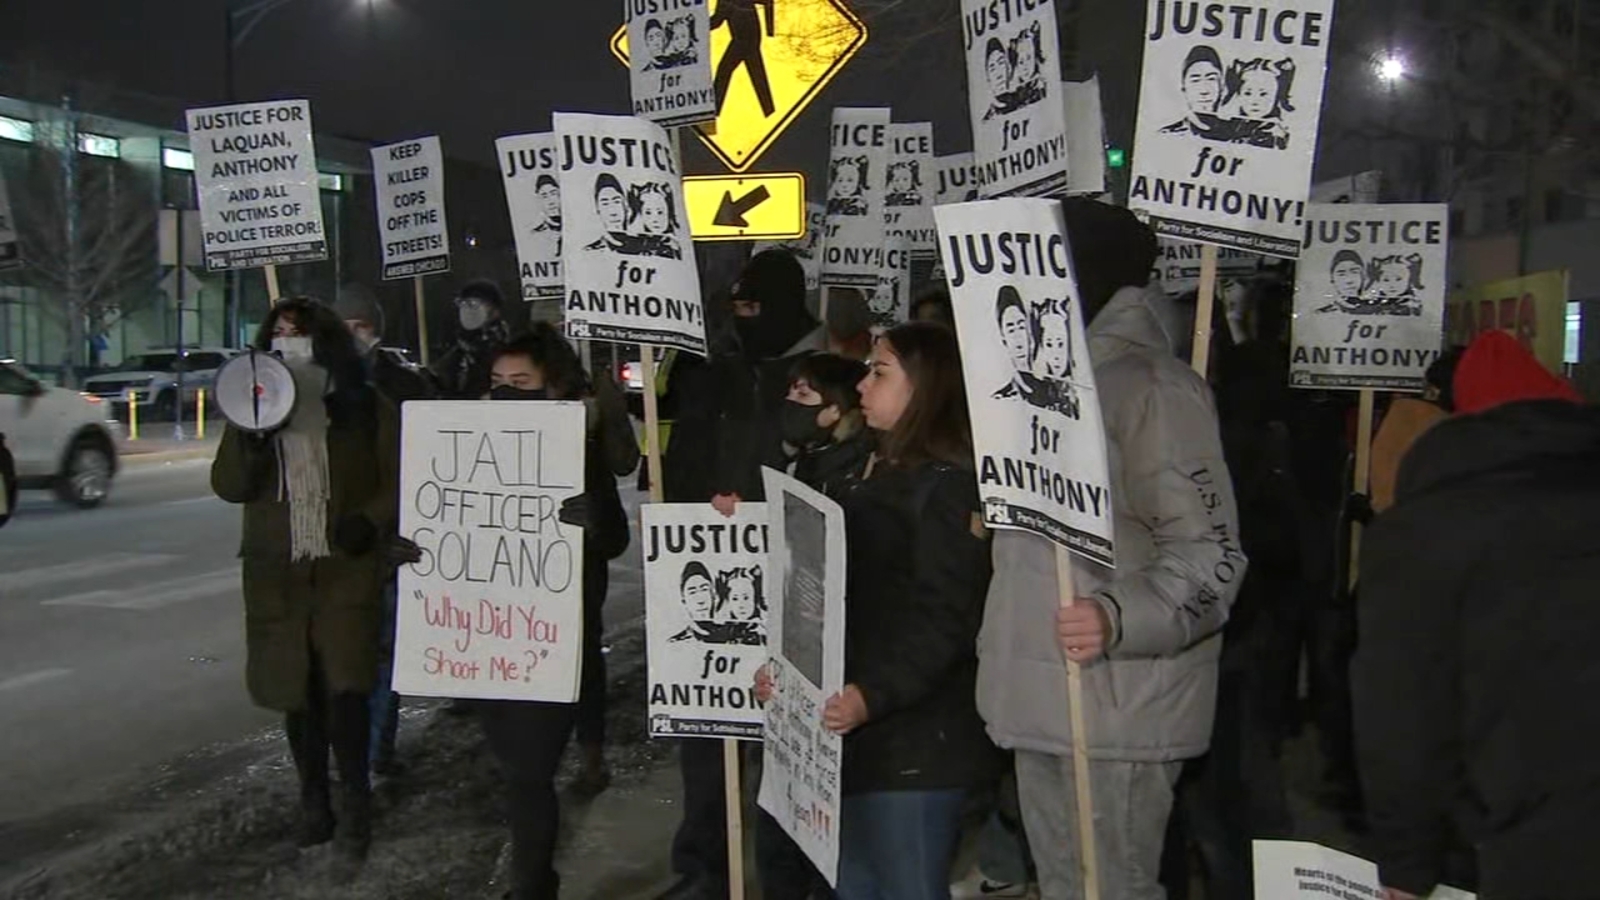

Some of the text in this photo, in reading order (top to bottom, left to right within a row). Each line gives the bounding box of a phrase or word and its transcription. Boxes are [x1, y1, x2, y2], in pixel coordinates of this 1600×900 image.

[1149, 0, 1323, 47] JUSTICE
[659, 72, 682, 93] for
[634, 87, 715, 114] ANTHONY!
[194, 106, 304, 131] JUSTICE FOR
[211, 131, 292, 154] LAQUAN,
[1002, 118, 1030, 151] for
[211, 154, 299, 178] ANTHONY
[389, 142, 422, 161] KEEP
[507, 147, 557, 178] JUS
[976, 133, 1066, 188] ANTHONY!
[1191, 147, 1244, 178] for
[387, 166, 429, 185] KILLER
[228, 185, 289, 203] AND ALL
[394, 191, 426, 208] COPS
[1131, 175, 1305, 226] ANTHONY!
[220, 203, 301, 223] VICTIMS OF
[387, 210, 438, 231] OFF THE
[206, 227, 257, 245] POLICE
[387, 234, 443, 257] STREETS!
[1302, 219, 1442, 249] JUSTICE
[615, 260, 656, 288] for
[567, 289, 703, 327] ANTHONY!
[1344, 319, 1388, 343] for
[1030, 414, 1061, 455] for
[431, 429, 574, 489] JAIL
[415, 480, 566, 538] OFFICER
[409, 527, 573, 593] SOLANO
[476, 599, 512, 640] Did
[517, 604, 558, 643] You
[423, 646, 480, 681] Shoot
[700, 649, 741, 679] for
